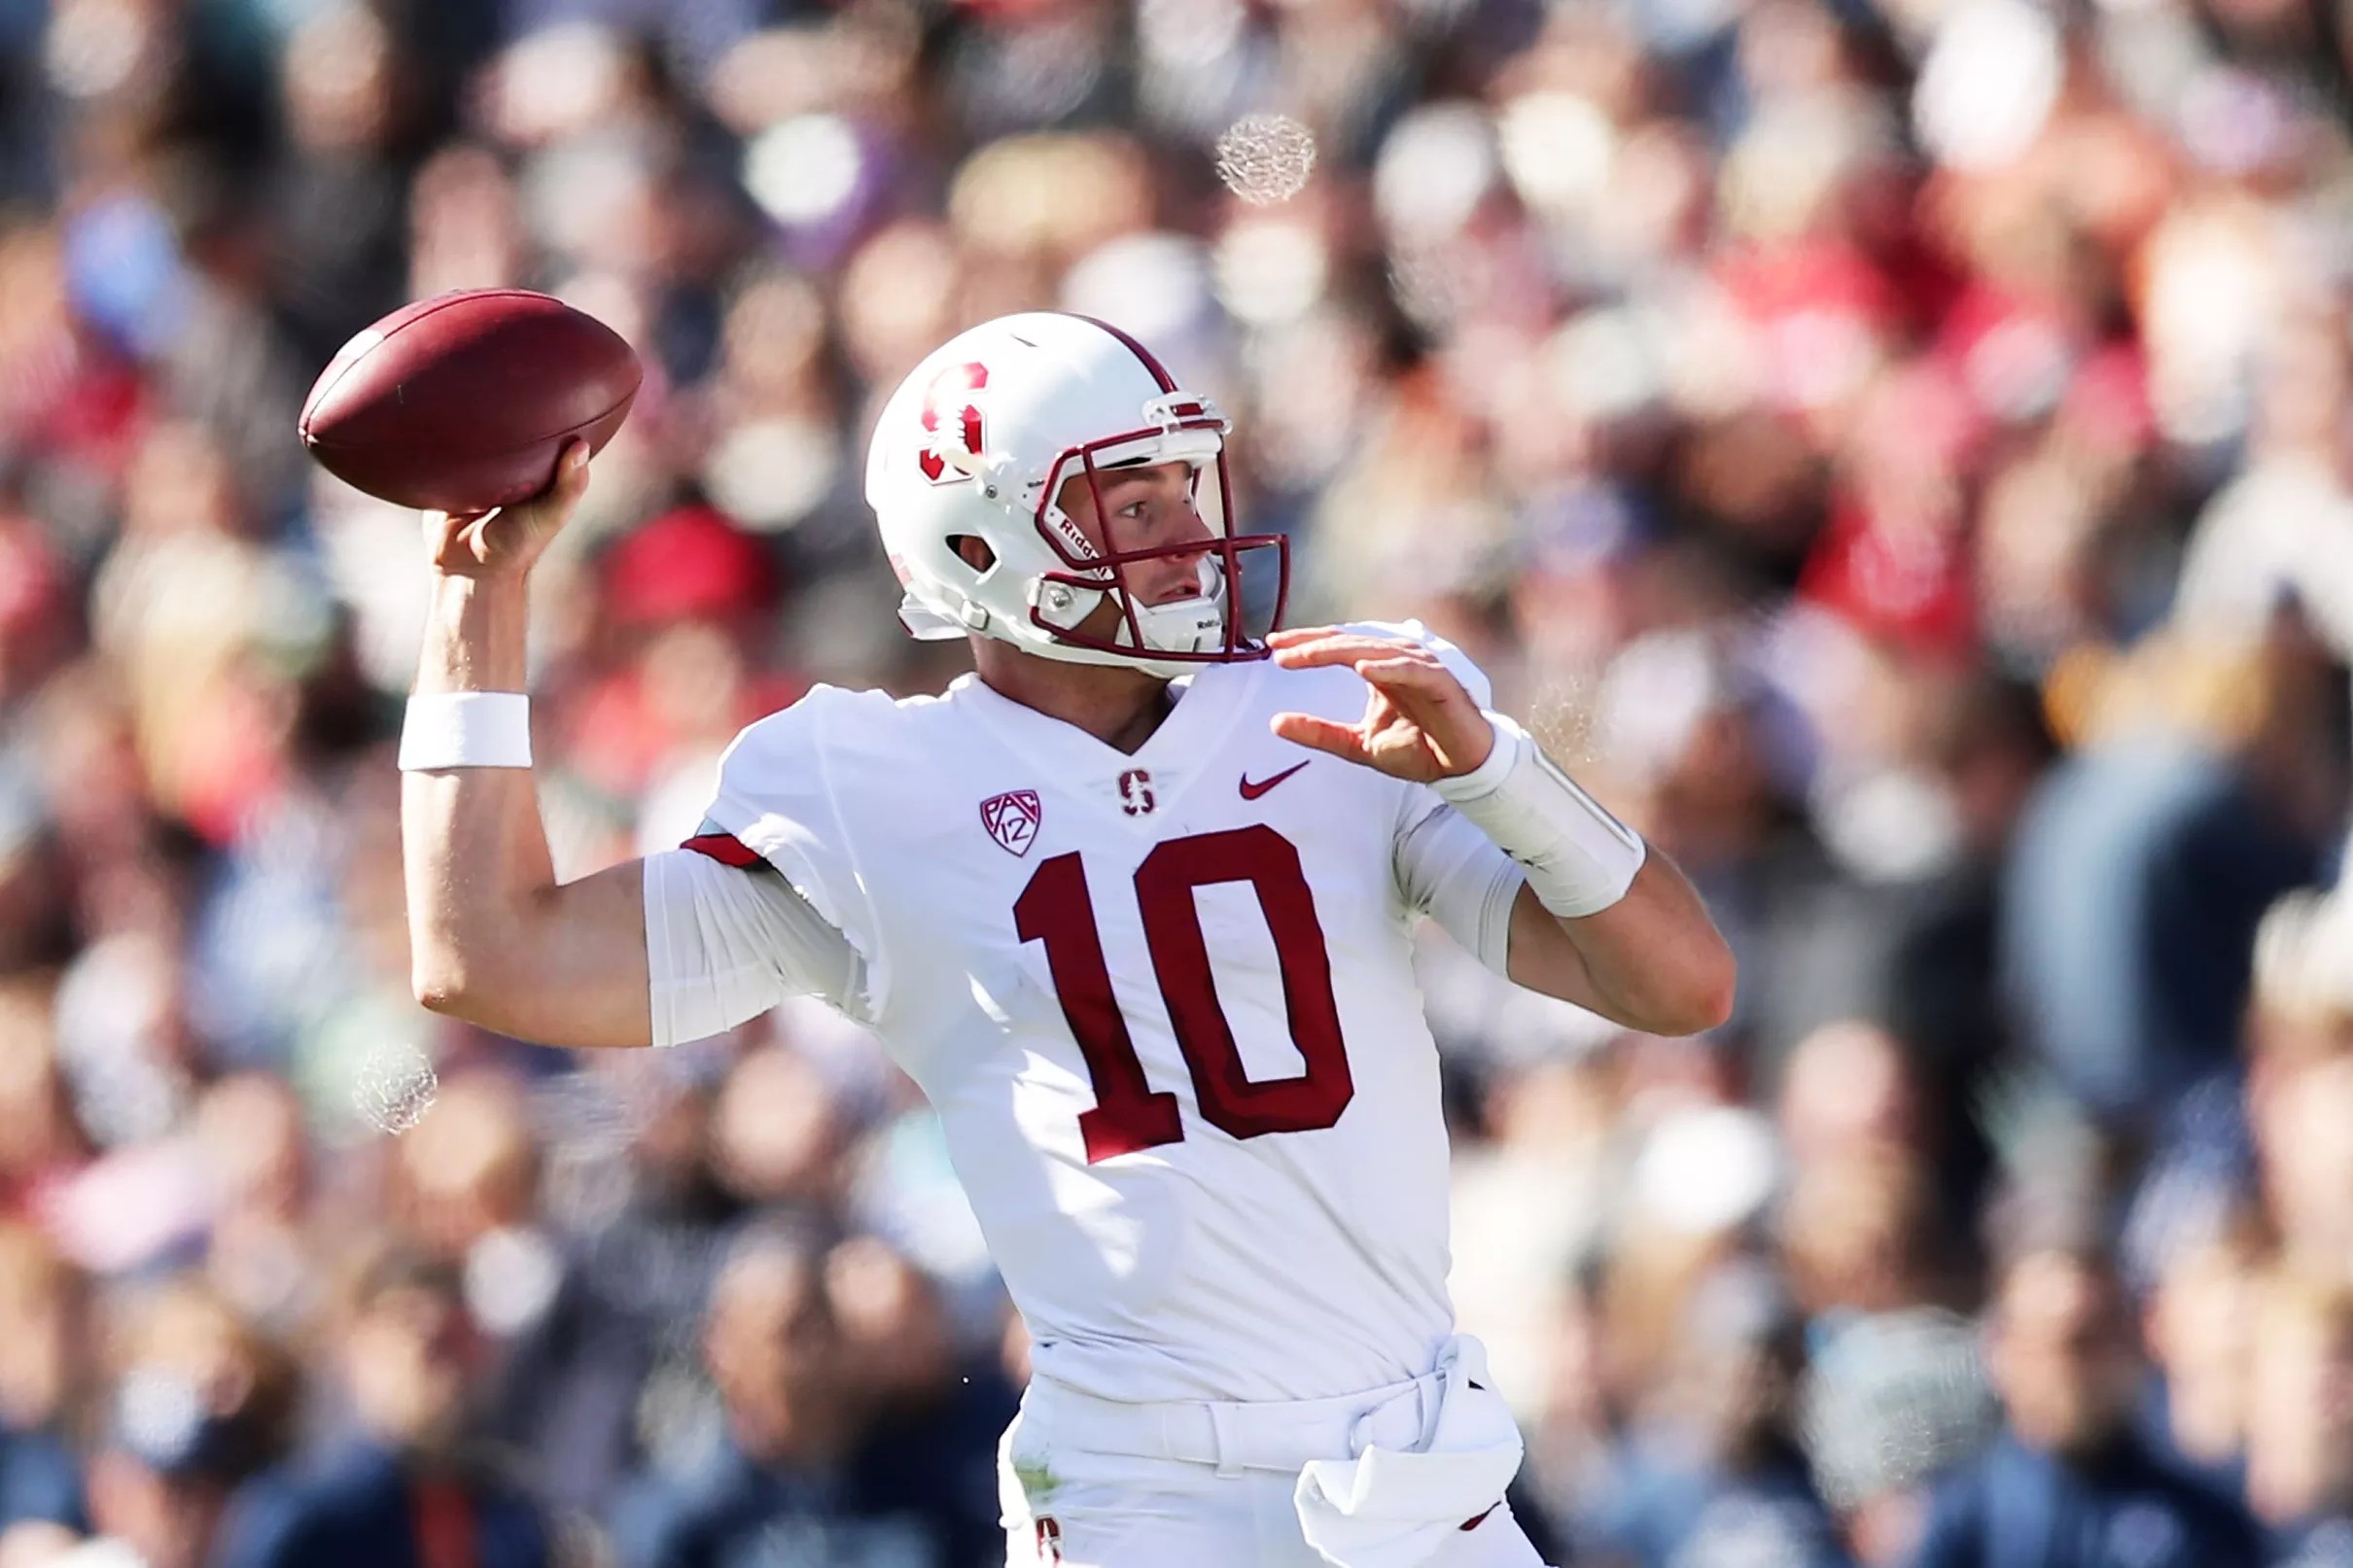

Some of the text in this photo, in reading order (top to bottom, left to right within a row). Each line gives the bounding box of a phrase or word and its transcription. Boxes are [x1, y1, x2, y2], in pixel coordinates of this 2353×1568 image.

[981, 791, 1038, 834] PAC
[1000, 817, 1031, 845] 12
[1012, 822, 1355, 1166] 10
